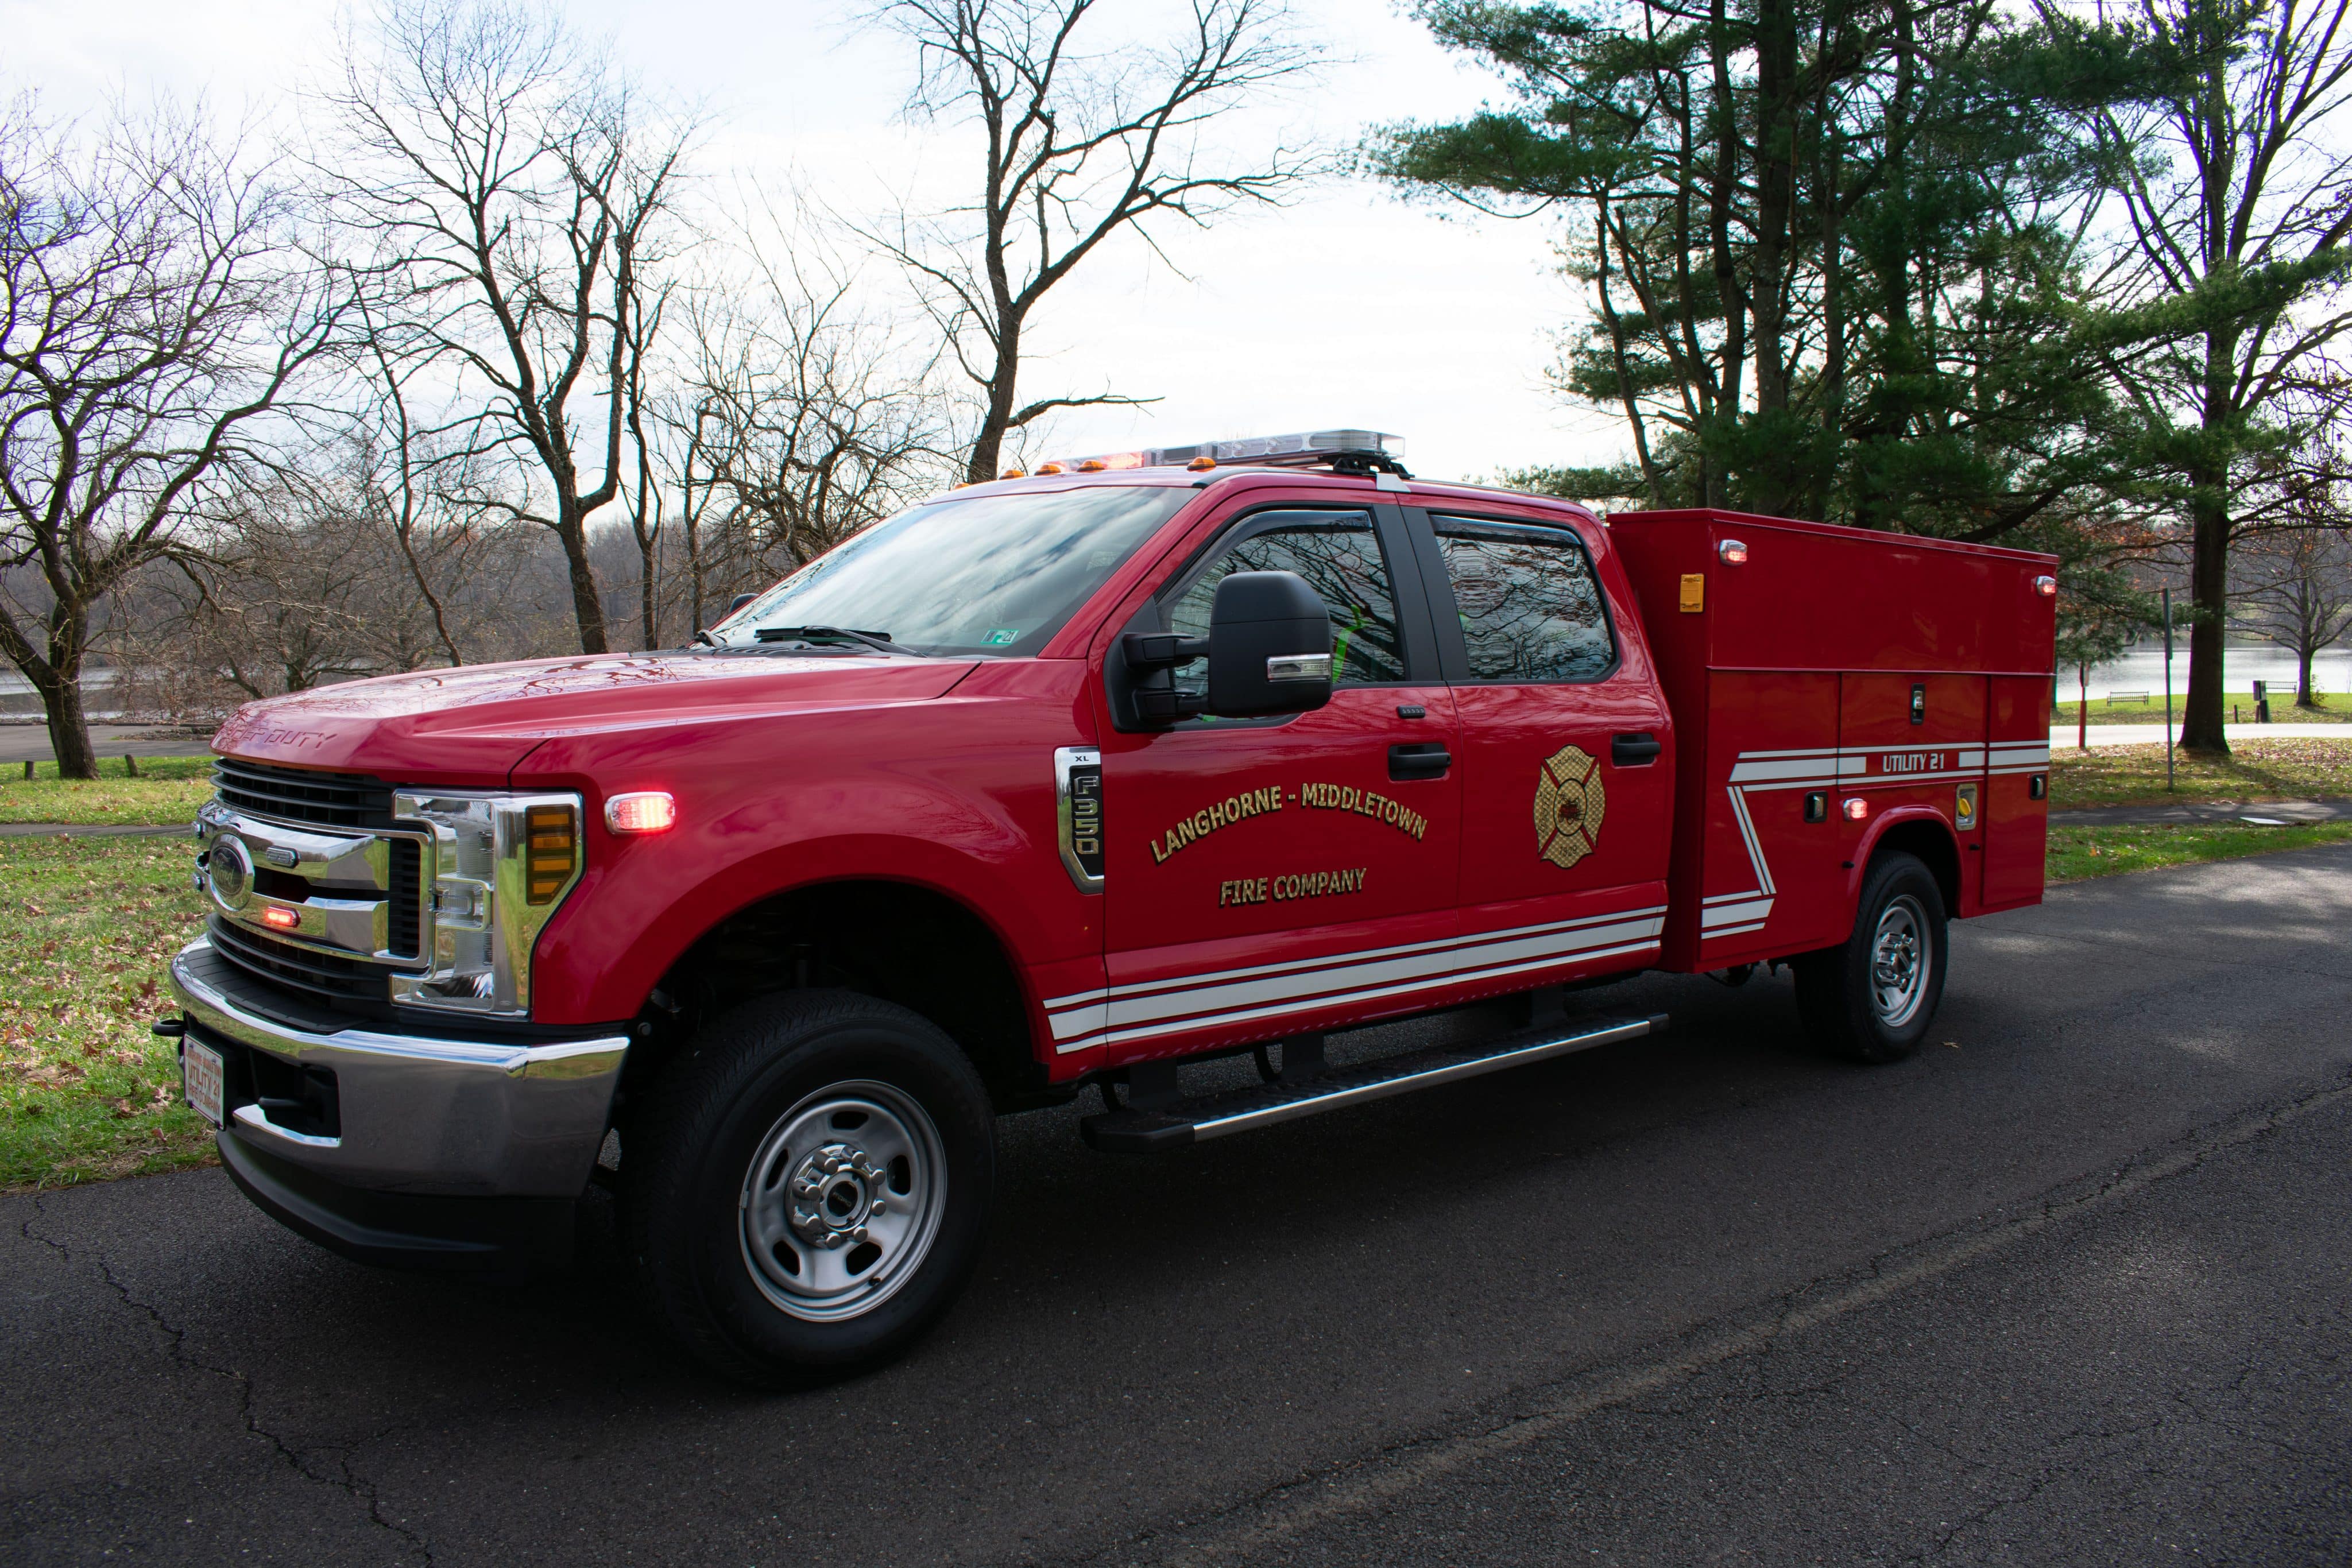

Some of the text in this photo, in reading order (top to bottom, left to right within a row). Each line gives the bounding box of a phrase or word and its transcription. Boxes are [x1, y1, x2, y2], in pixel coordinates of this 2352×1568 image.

[265, 729, 338, 749] DUTY
[1554, 755, 1589, 771] ORGANIZED
[1883, 753, 1945, 772] UTILITY 21
[1074, 776, 1099, 855] F350
[1150, 785, 1282, 864] LANGHORNE
[1301, 783, 1428, 841] MIDDLETOWN
[1219, 868, 1367, 907] FIRE COMPANY
[188, 1062, 211, 1091] UTILITY
[213, 1079, 220, 1098] 21
